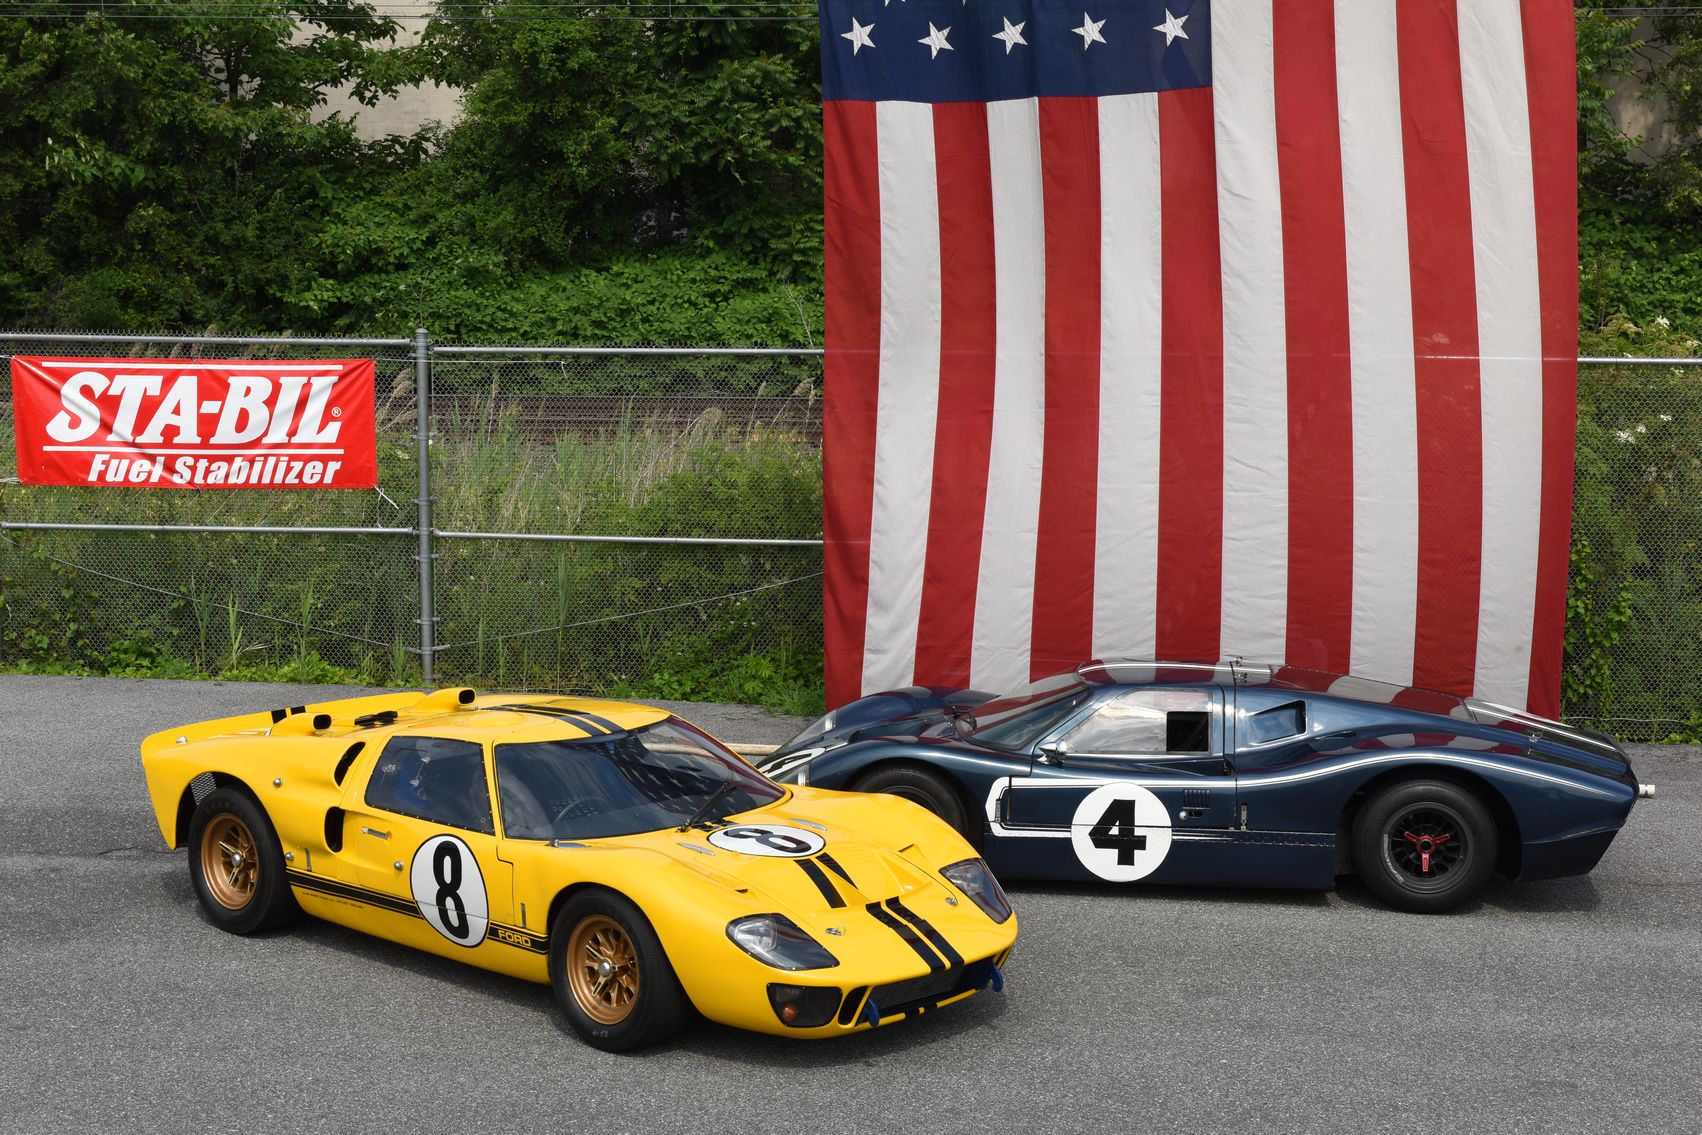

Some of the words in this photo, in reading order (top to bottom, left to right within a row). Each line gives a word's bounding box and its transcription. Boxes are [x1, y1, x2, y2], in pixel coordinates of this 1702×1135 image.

[88, 454, 164, 484] Fuel
[172, 456, 341, 485] Stabilizer
[722, 827, 812, 854] 8
[1088, 798, 1147, 867] 4
[432, 839, 470, 940] 8
[497, 929, 532, 947] FORD
